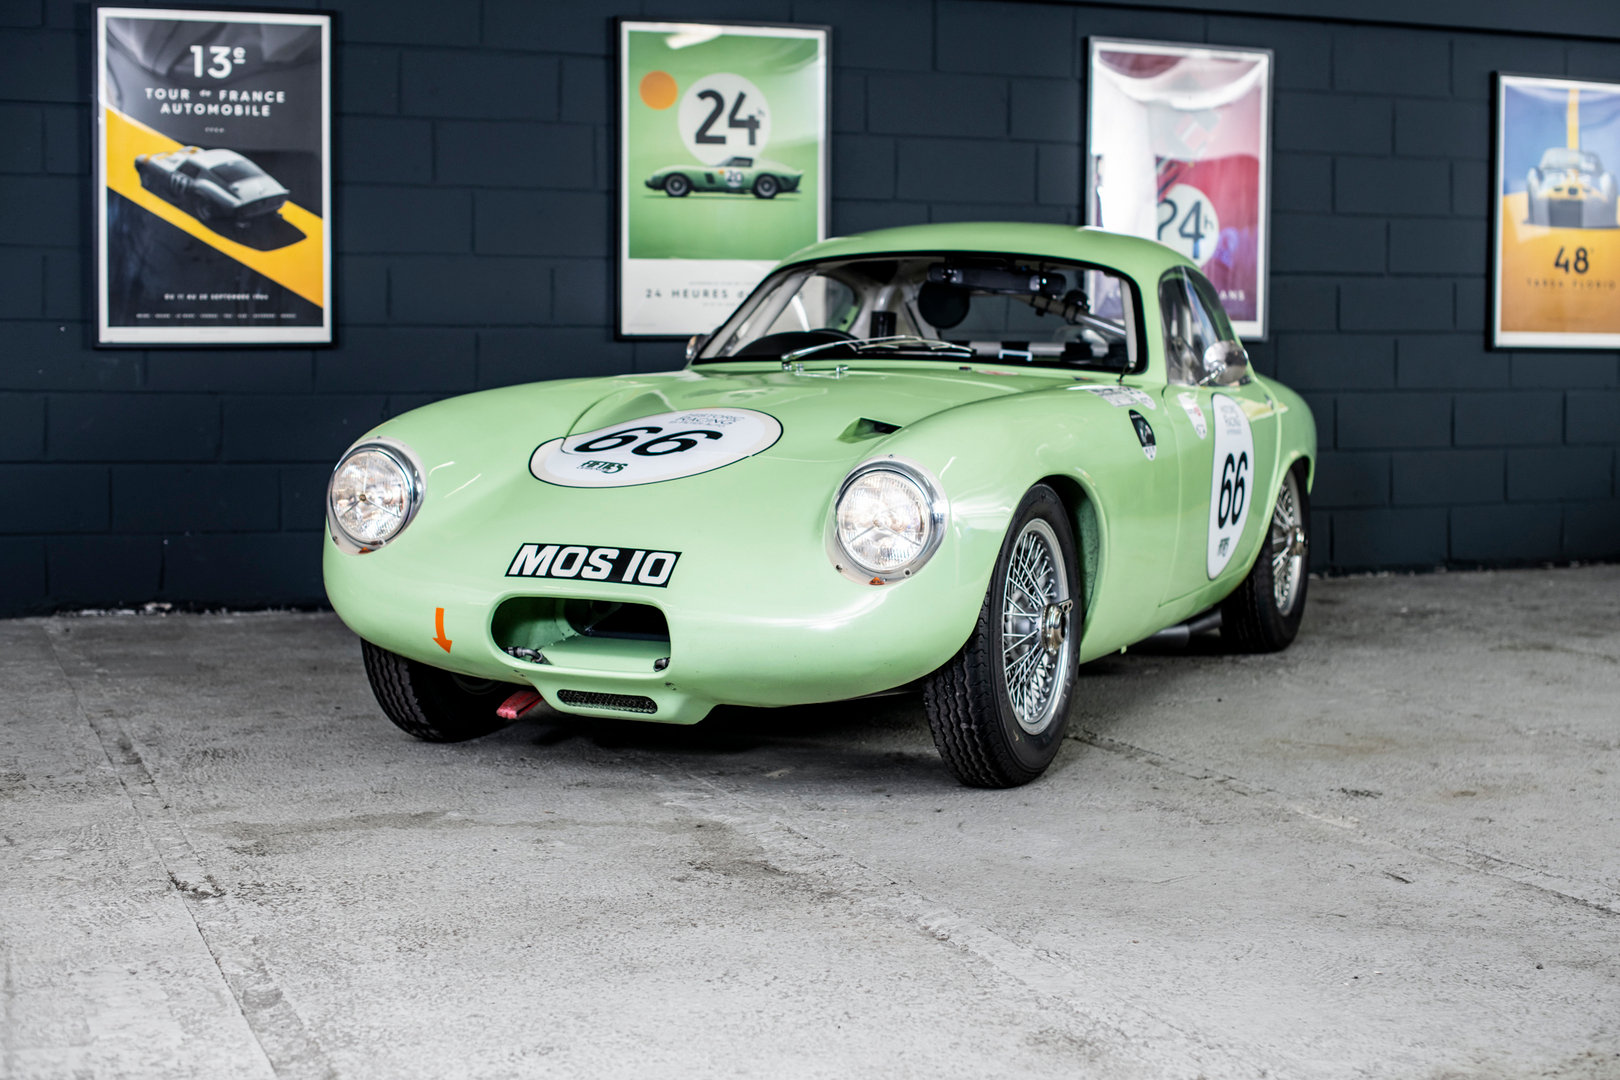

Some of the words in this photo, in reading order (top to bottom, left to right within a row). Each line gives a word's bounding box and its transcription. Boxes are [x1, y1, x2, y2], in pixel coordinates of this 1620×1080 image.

[144, 87, 190, 101] TOUR
[219, 89, 286, 104] FRANCE
[160, 102, 271, 117] AUTOMOBILE
[727, 169, 745, 184] 20
[645, 288, 662, 299] 24
[671, 288, 729, 299] HEURES
[1219, 290, 1246, 301] ANS
[573, 426, 723, 457] 66
[1217, 451, 1248, 530] 66
[508, 544, 620, 580] MOS
[621, 550, 677, 585] 10
